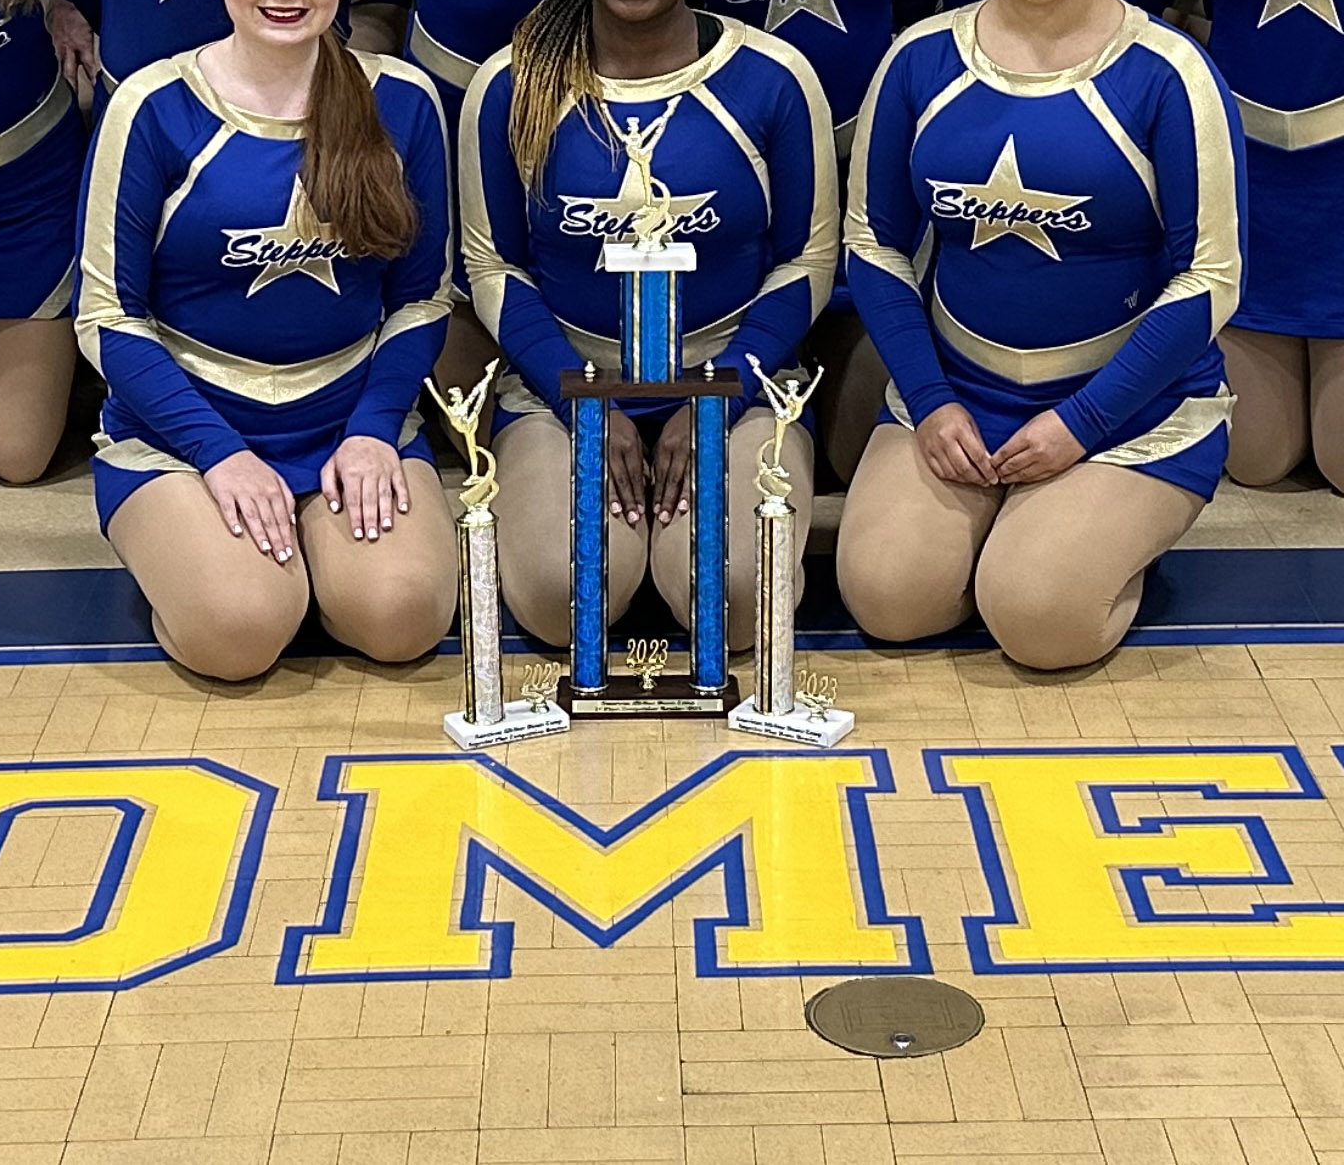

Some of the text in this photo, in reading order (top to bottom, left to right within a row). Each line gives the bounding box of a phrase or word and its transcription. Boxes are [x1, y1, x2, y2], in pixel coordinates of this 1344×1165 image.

[559, 202, 721, 242] Steprs
[931, 187, 1092, 232] Steppers
[221, 232, 351, 268] Stepper
[626, 637, 669, 667] 2023
[796, 669, 838, 706] 2023
